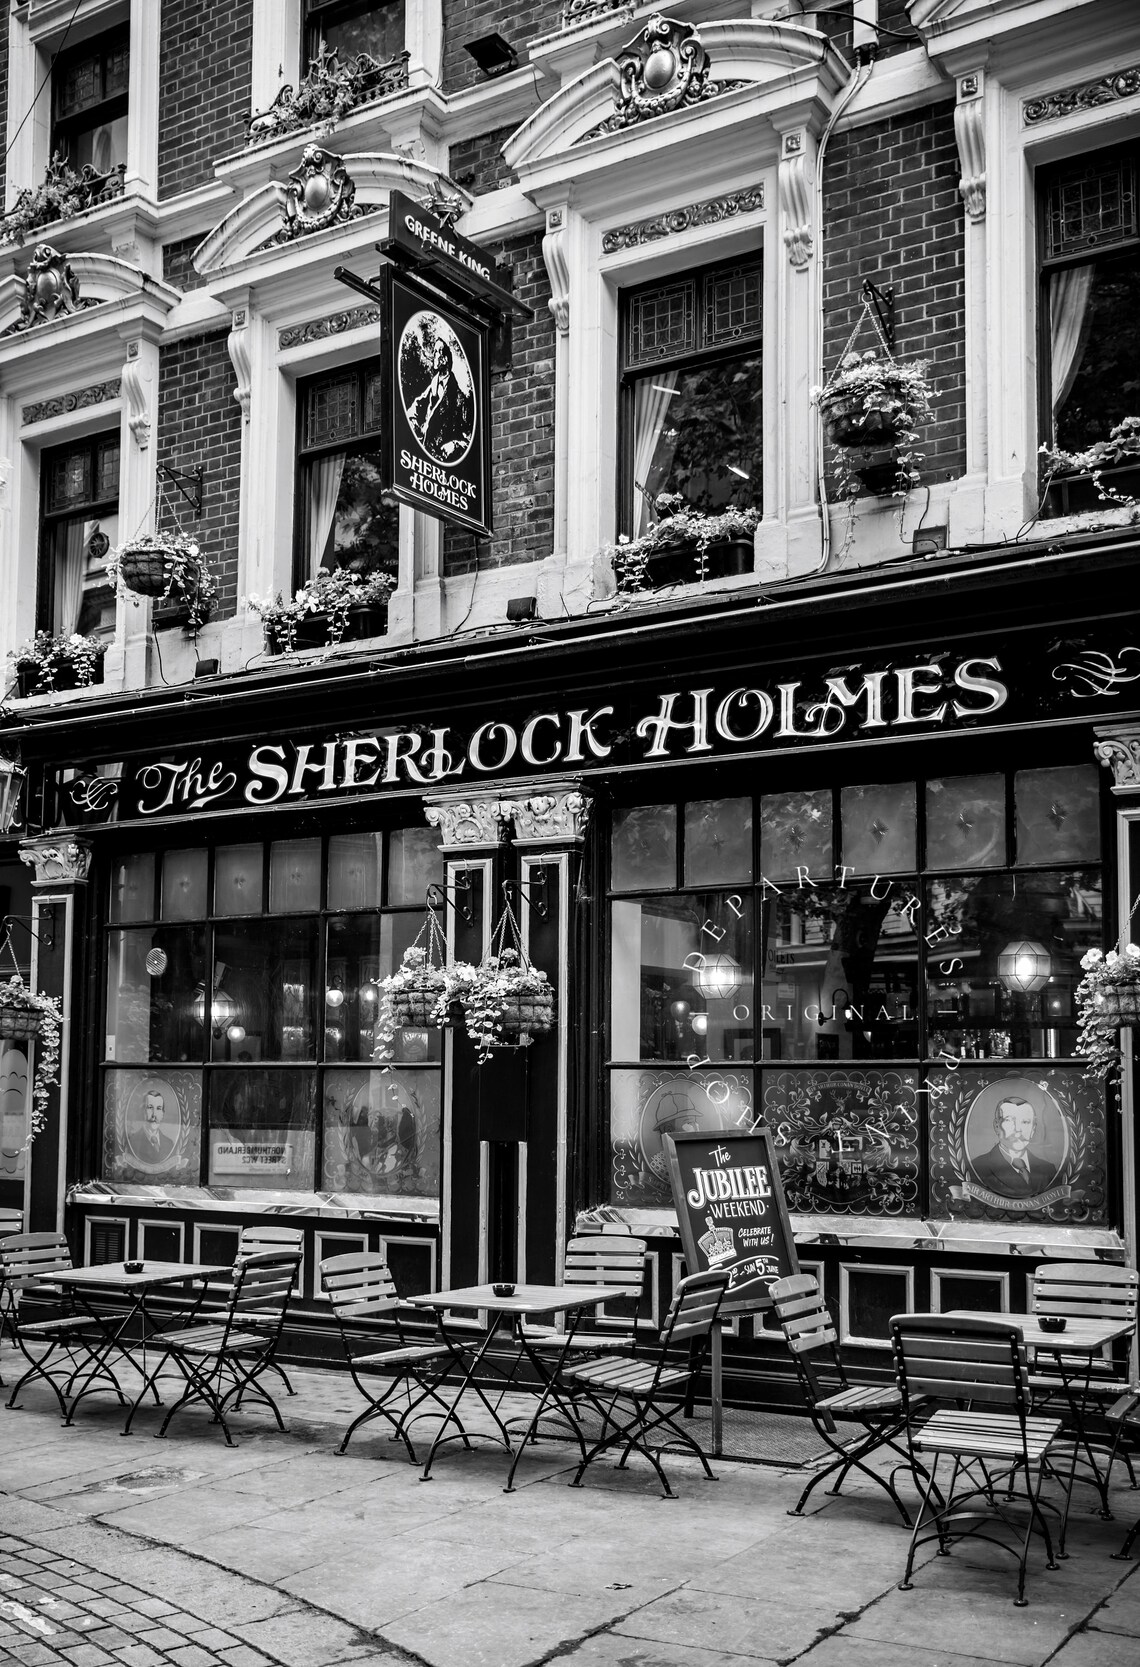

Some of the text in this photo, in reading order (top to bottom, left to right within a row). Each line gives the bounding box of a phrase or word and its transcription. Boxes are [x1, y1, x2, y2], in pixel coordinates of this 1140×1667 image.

[404, 214, 490, 281] GREENE KING
[400, 449, 477, 499] SHERLOCK
[409, 471, 469, 511] HOLMES
[135, 656, 1009, 814] The SHERLOCK HOLMES
[708, 1145, 732, 1167] The
[687, 1165, 772, 1209] JUBILEE
[966, 1184, 980, 1196] SIR
[980, 1190, 1010, 1207] ARTHUR
[1011, 1198, 1041, 1209] CONAN
[709, 1199, 766, 1219] WEEKEND
[738, 1226, 772, 1238] CELEBRATE
[742, 1233, 775, 1247] WITH US!
[743, 1262, 757, 1275] SUN
[765, 1264, 780, 1274] JUNE
